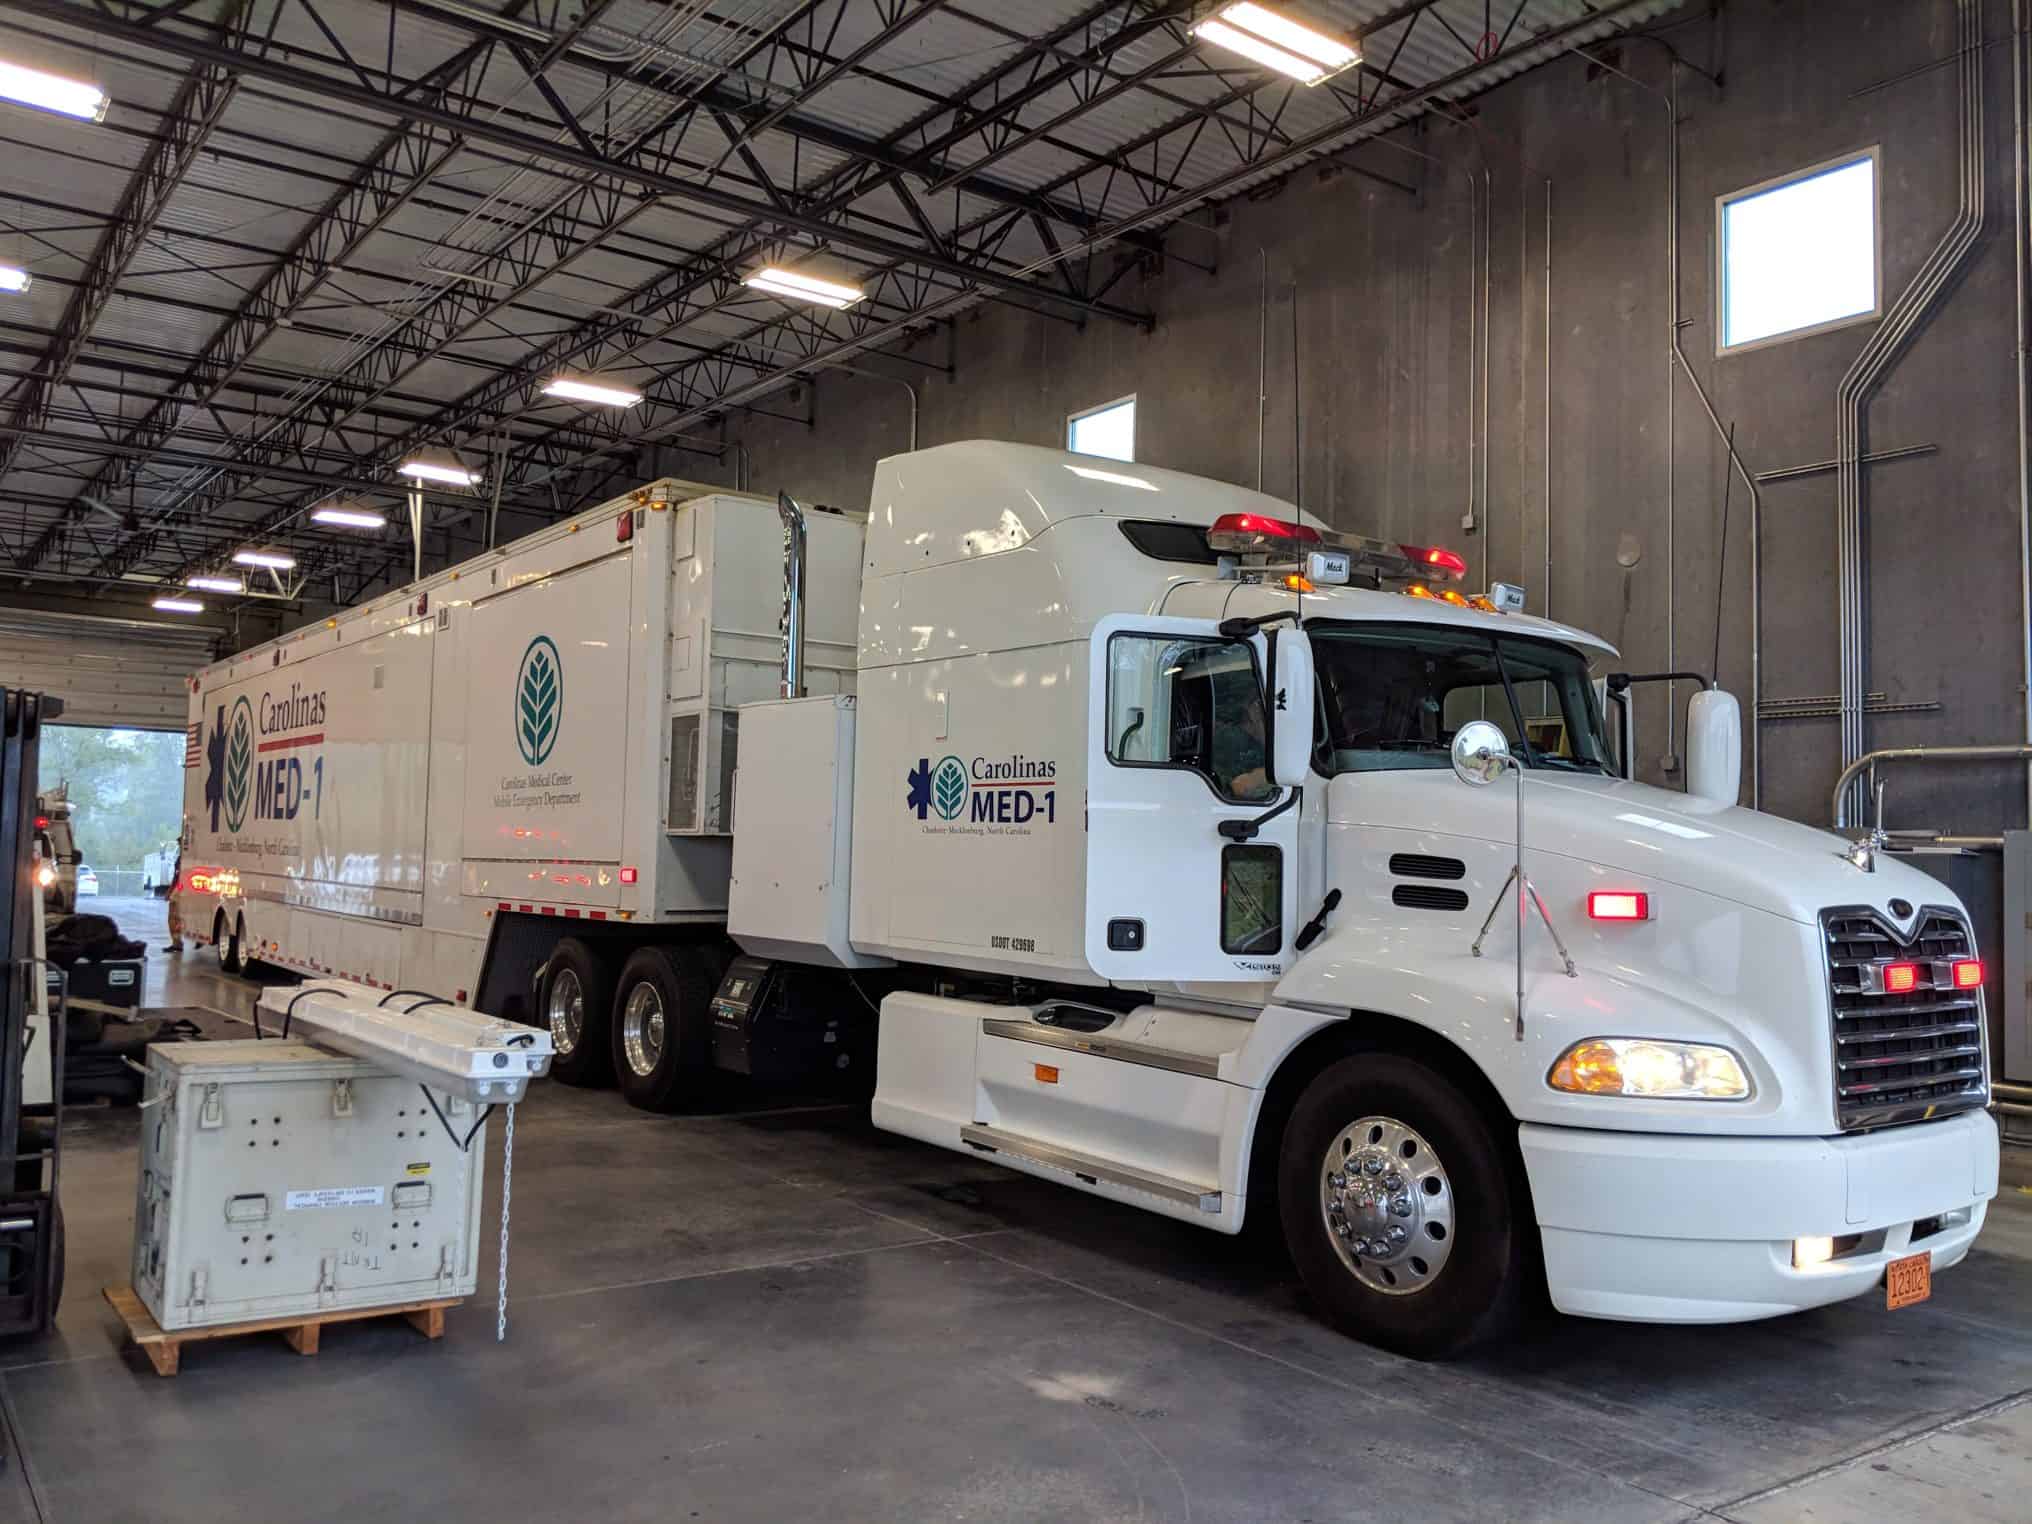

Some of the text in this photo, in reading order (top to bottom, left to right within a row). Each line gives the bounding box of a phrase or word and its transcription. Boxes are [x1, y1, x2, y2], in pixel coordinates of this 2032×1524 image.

[259, 682, 327, 736] Carolinas
[254, 755, 324, 821] MED-1
[971, 754, 1056, 780] Carolinas
[970, 790, 1056, 823] MED-1
